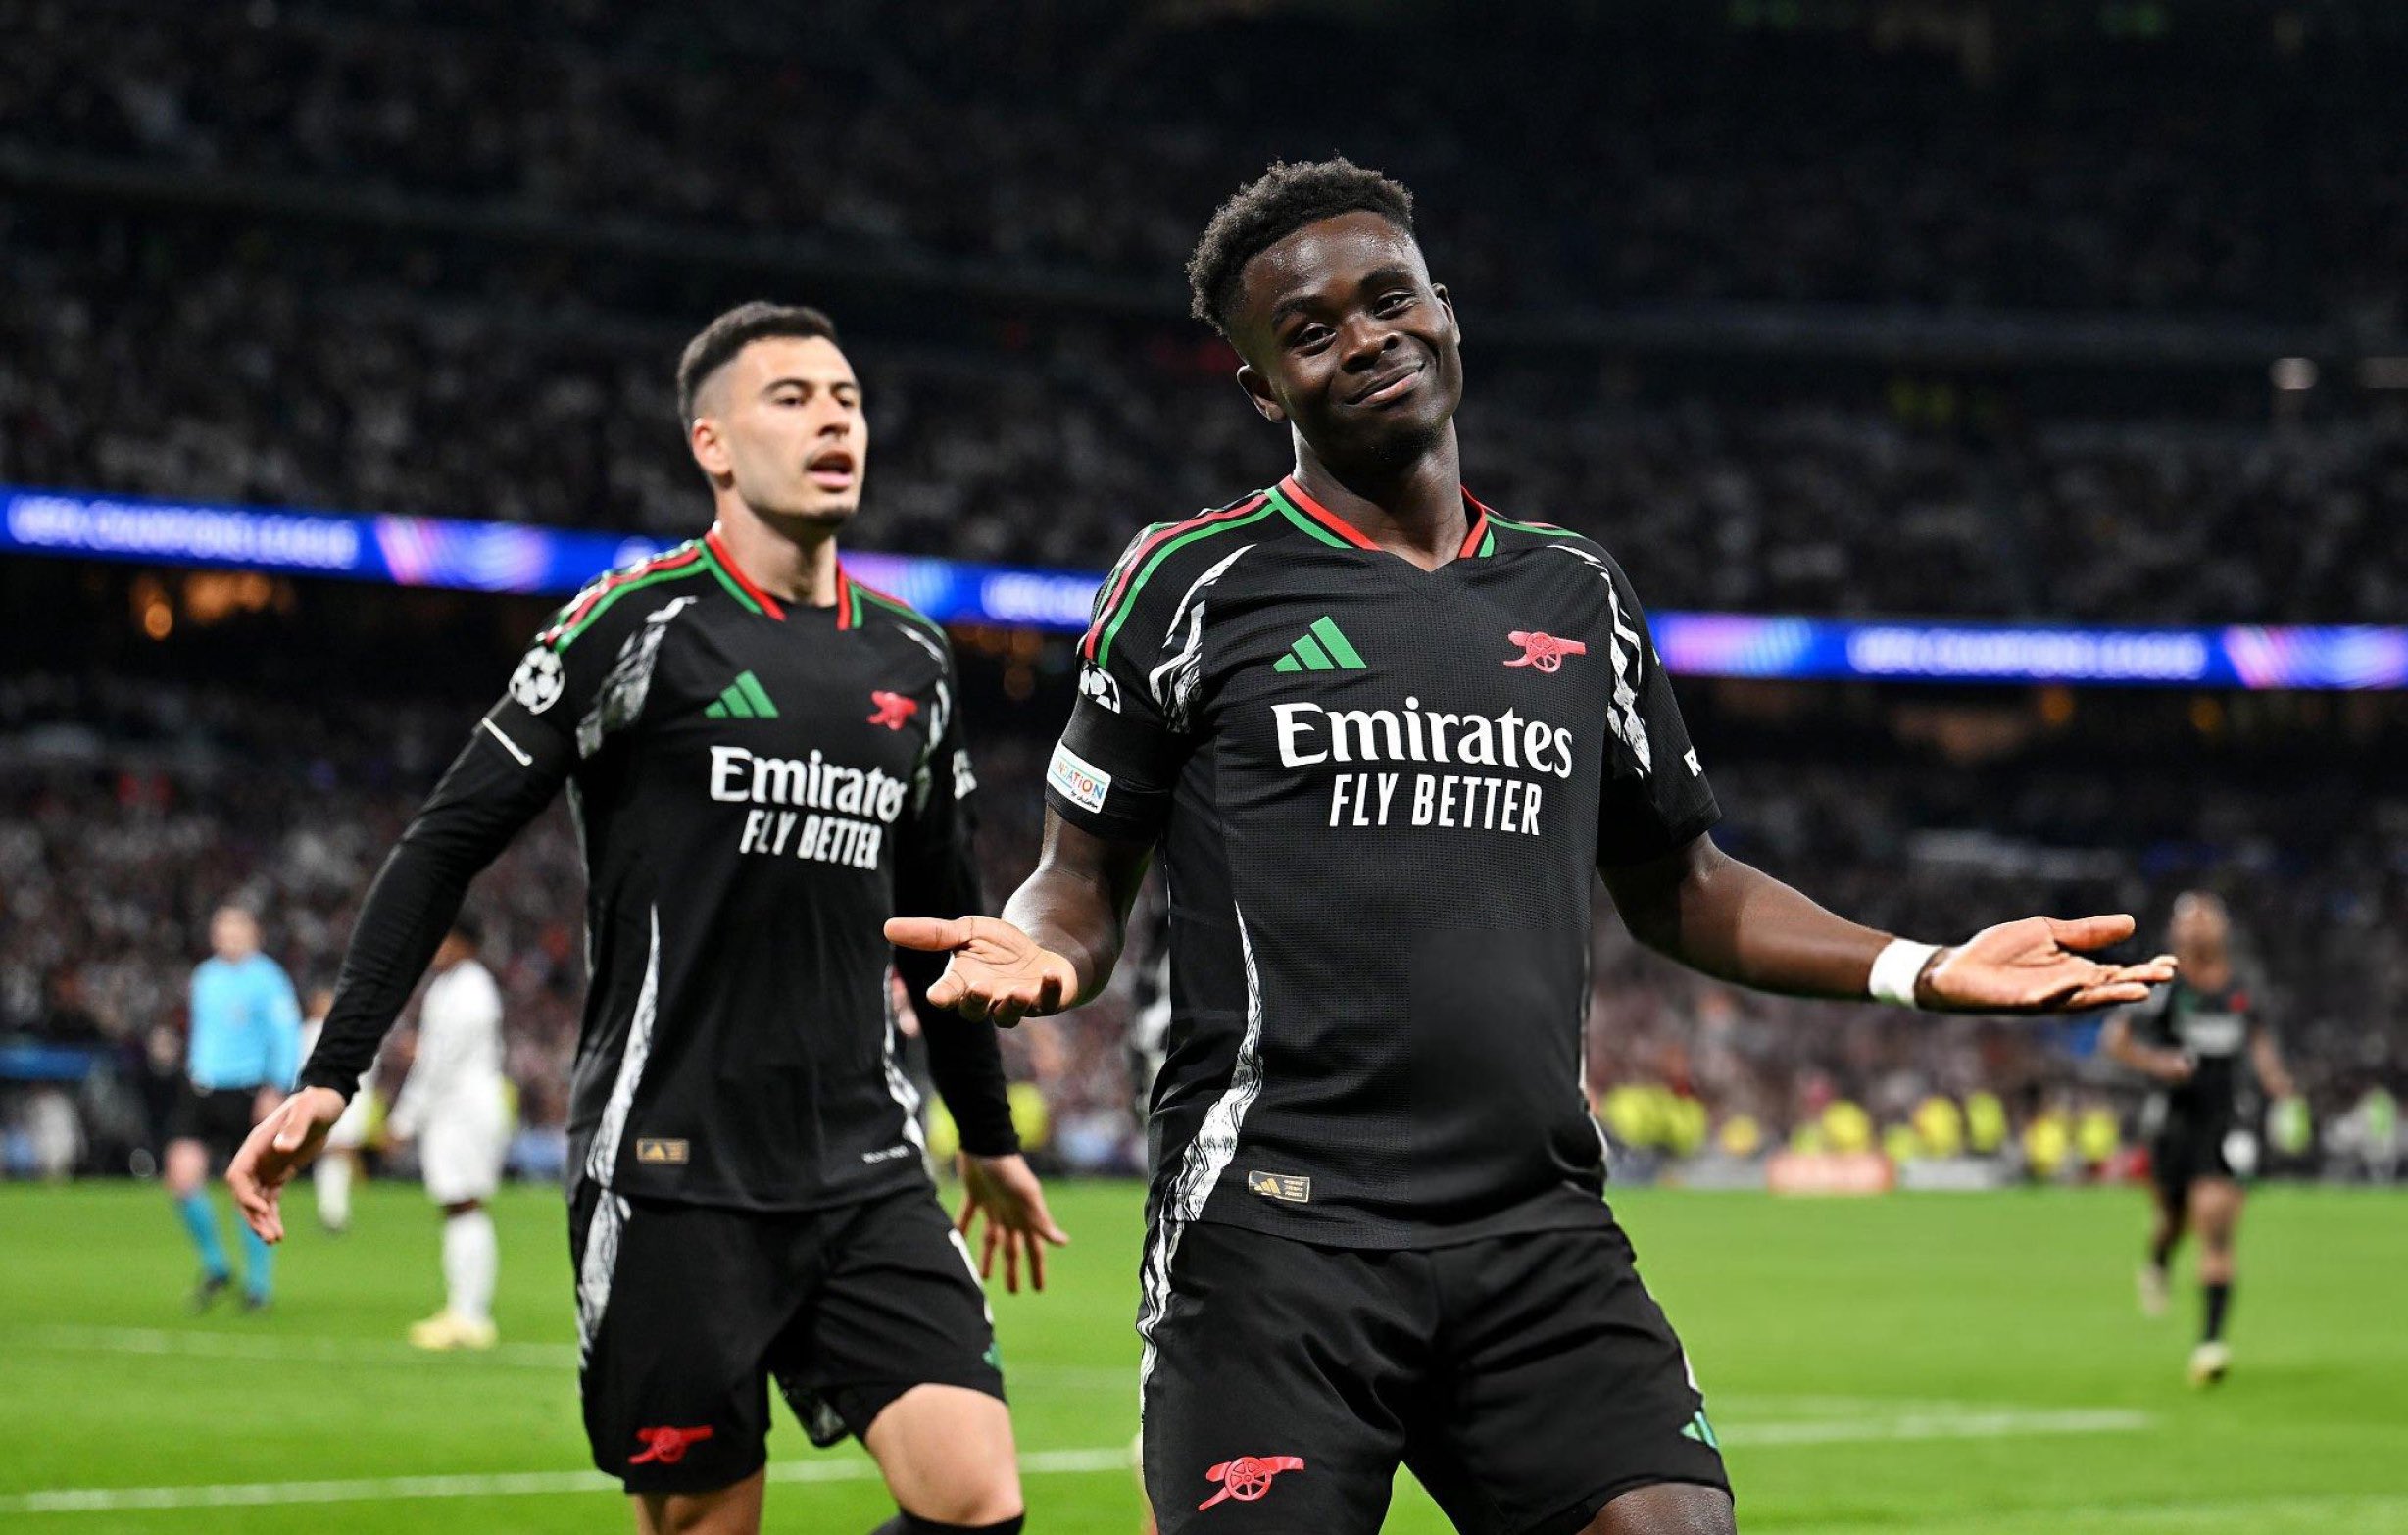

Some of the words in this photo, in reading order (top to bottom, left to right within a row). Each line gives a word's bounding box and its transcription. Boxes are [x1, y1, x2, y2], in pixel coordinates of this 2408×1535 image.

[1270, 696, 1573, 779] Emirates
[710, 745, 908, 823] Emirate
[1329, 772, 1399, 827] FLY
[1411, 773, 1543, 836] BETTER
[739, 809, 798, 854] FLY
[796, 813, 882, 870] BETTER
